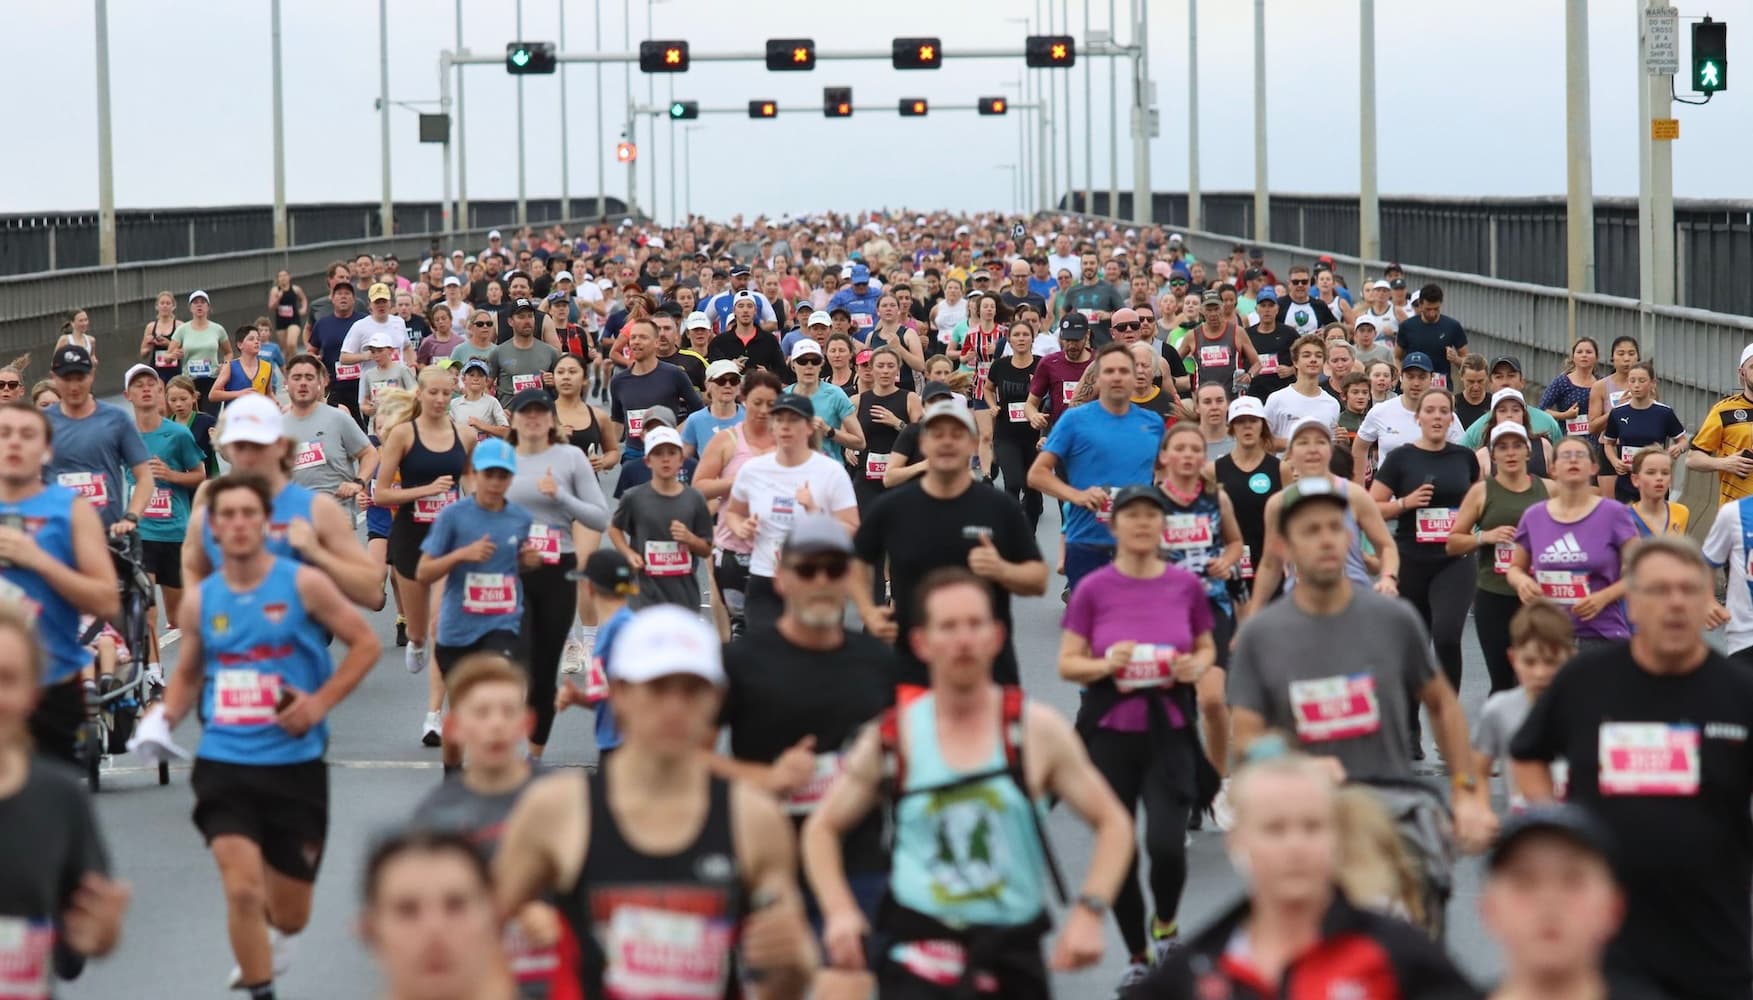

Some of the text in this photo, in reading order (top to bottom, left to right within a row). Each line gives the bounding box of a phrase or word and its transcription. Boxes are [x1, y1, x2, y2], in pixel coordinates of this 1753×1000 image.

[1646, 8, 1678, 16] WARNING
[76, 485, 96, 497] 739
[149, 497, 165, 506] OTT
[425, 500, 449, 510] ALIC
[1427, 519, 1451, 528] EMILY
[654, 552, 682, 563] MISHA
[1538, 550, 1588, 563] adidas
[1551, 585, 1575, 597] 3176
